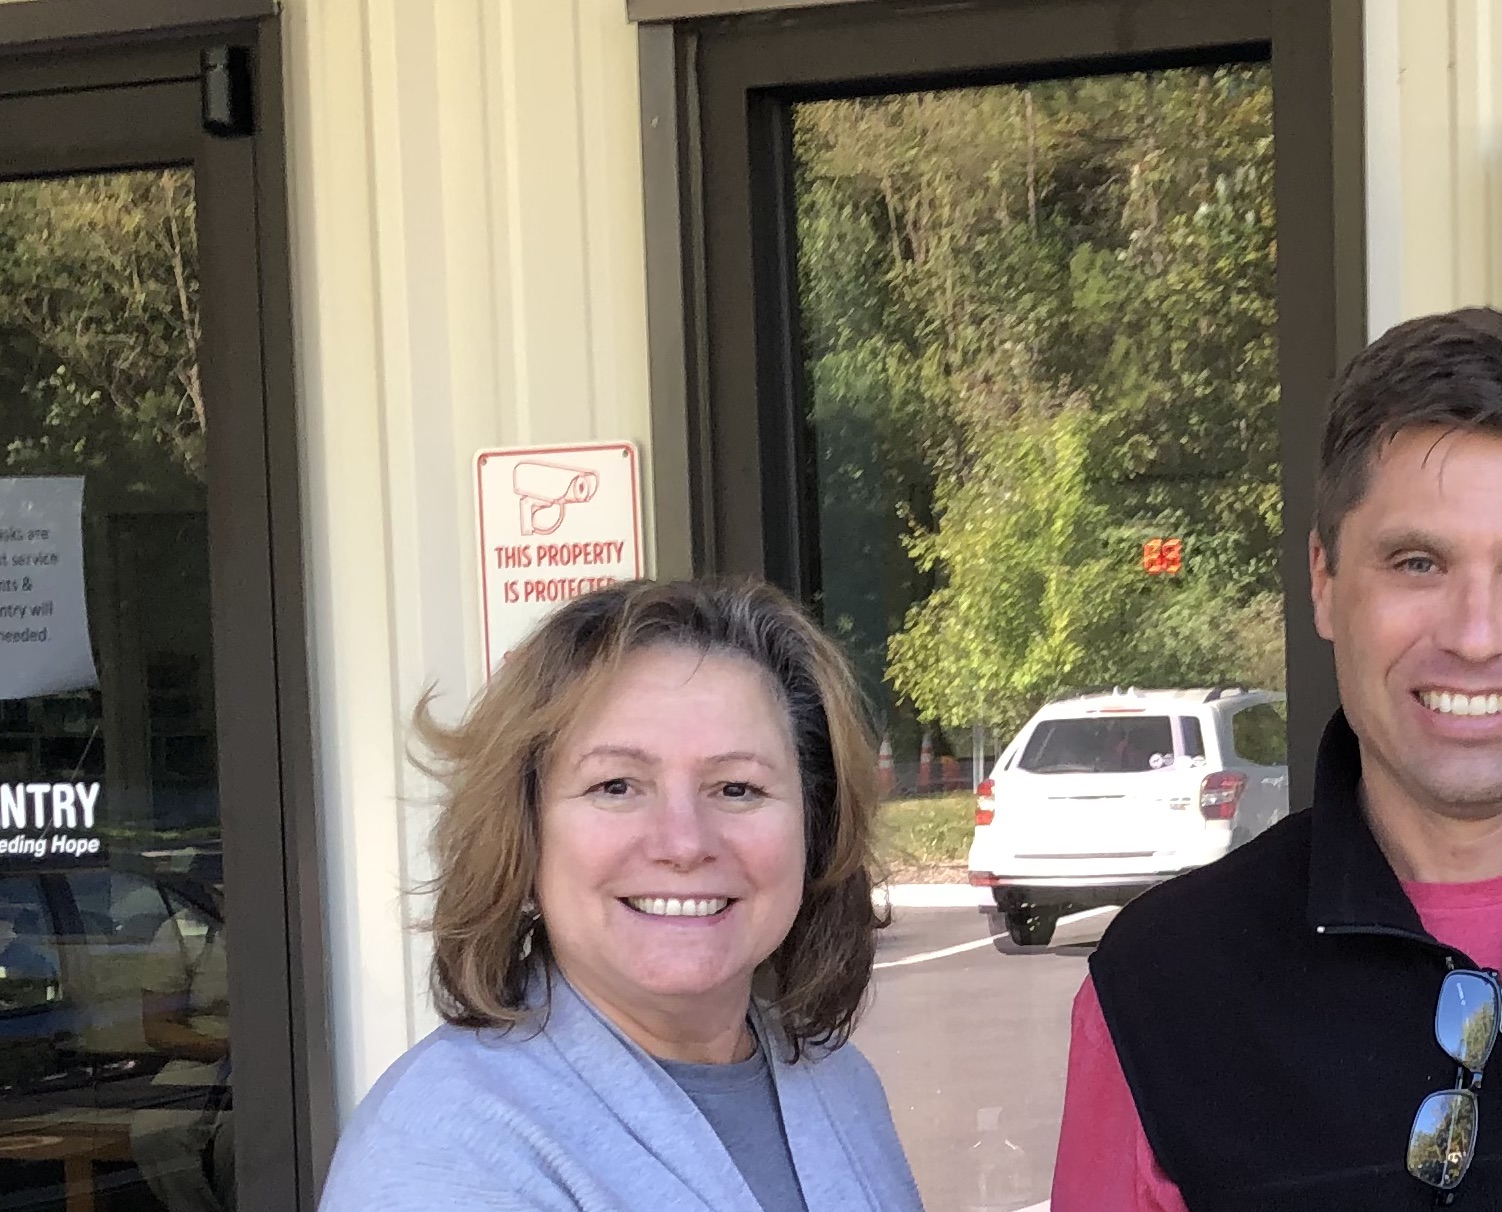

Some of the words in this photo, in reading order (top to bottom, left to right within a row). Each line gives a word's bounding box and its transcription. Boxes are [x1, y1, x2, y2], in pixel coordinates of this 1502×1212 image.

[494, 544, 532, 569] THIS
[536, 541, 624, 567] PROPERTY
[504, 580, 519, 604] IS
[0, 781, 100, 829] NTRY
[0, 834, 47, 858] eding
[50, 834, 100, 858] Hope
